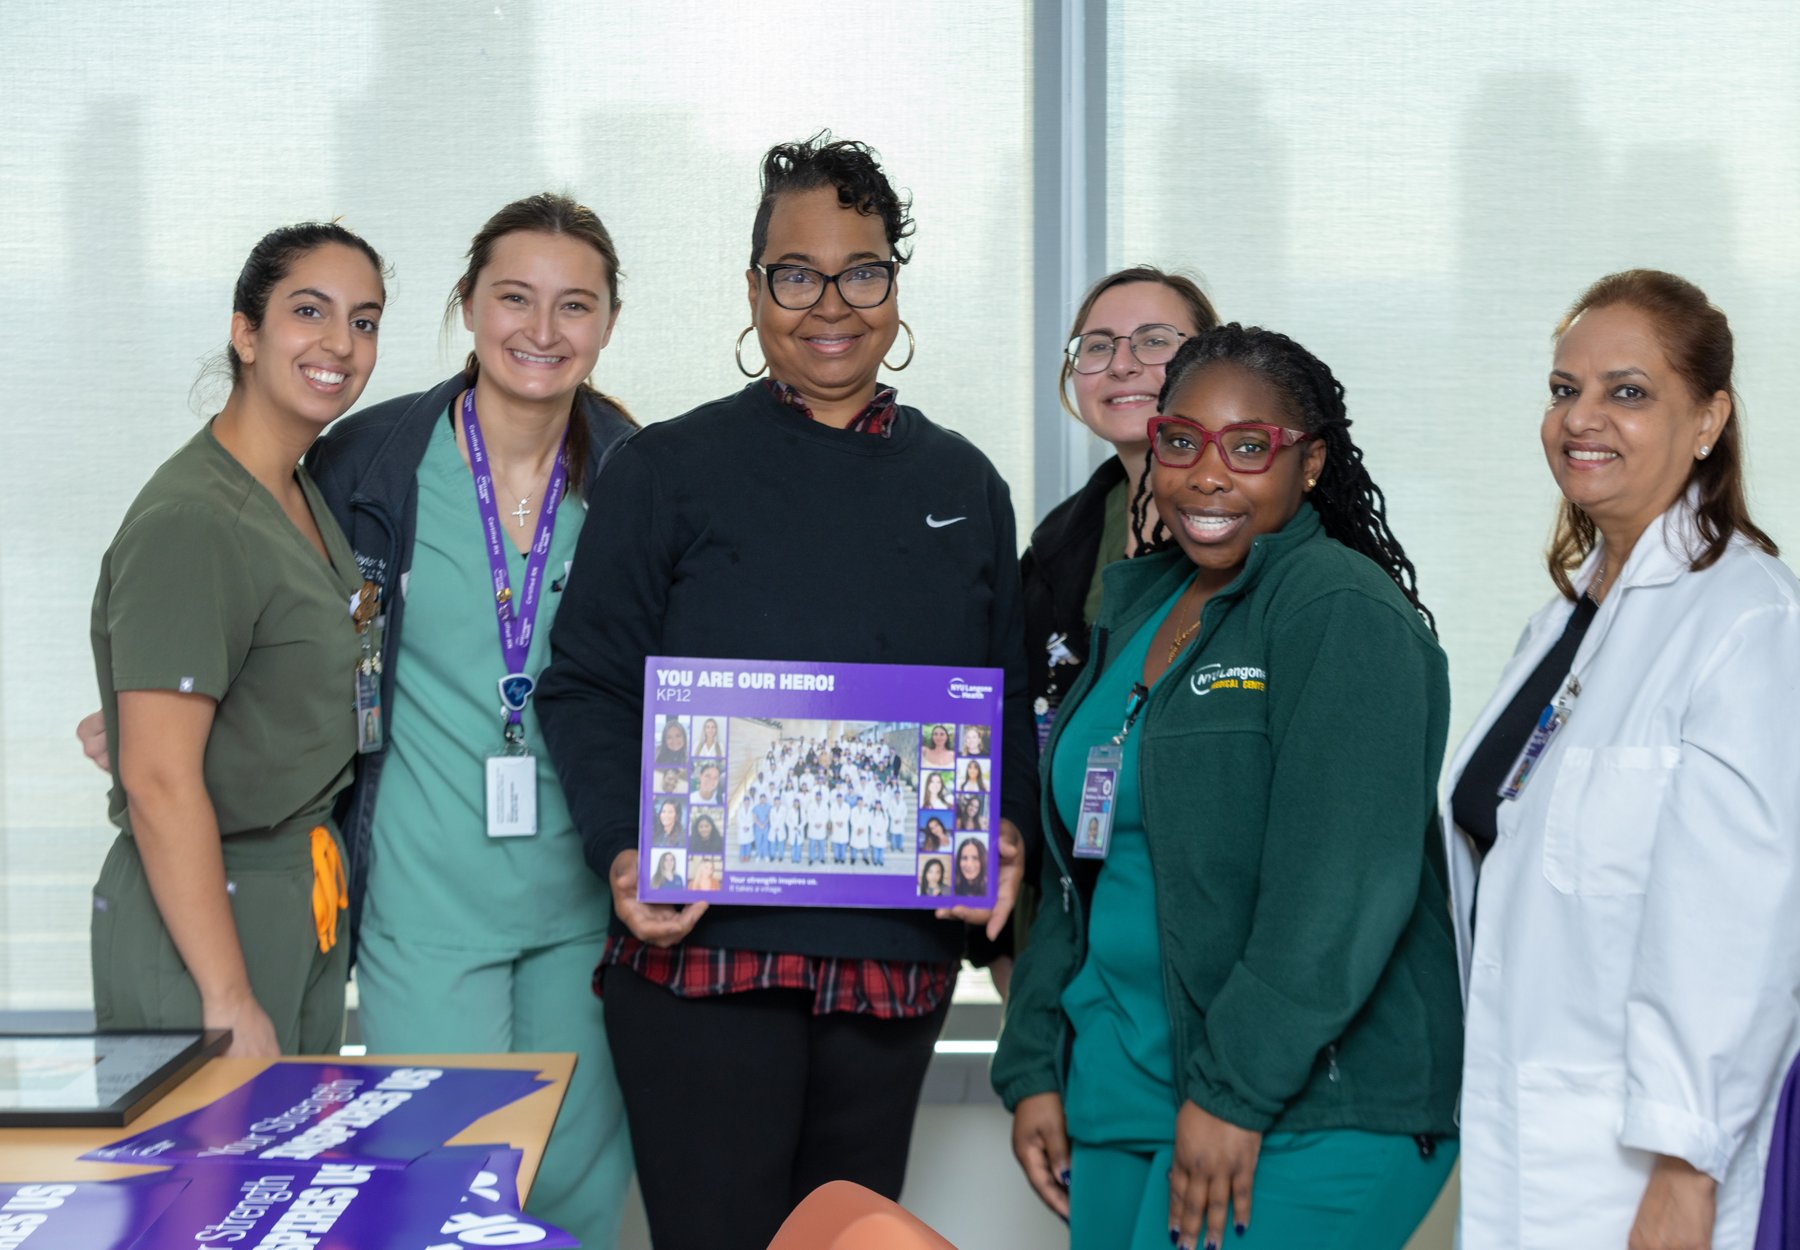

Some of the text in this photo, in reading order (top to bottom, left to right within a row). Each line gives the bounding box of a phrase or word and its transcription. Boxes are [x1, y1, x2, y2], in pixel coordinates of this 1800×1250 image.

[469, 424, 482, 462] Certified RN
[546, 488, 558, 514] Certified
[488, 516, 500, 555] Certified RN
[526, 578, 536, 604] Certified
[656, 670, 835, 692] YOU ARE OUR HERO!
[951, 684, 993, 694] NYU Langone
[1242, 679, 1265, 692] CENTE
[656, 688, 691, 702] KP12
[730, 876, 746, 884] Your
[746, 876, 777, 886] strength
[778, 876, 806, 886] inspires
[197, 1132, 277, 1158] Your
[250, 1079, 364, 1133] Strength
[258, 1068, 444, 1160] INSPIRES US
[310, 1164, 377, 1186] U
[1, 1183, 77, 1211] US
[194, 1175, 296, 1242] Strength
